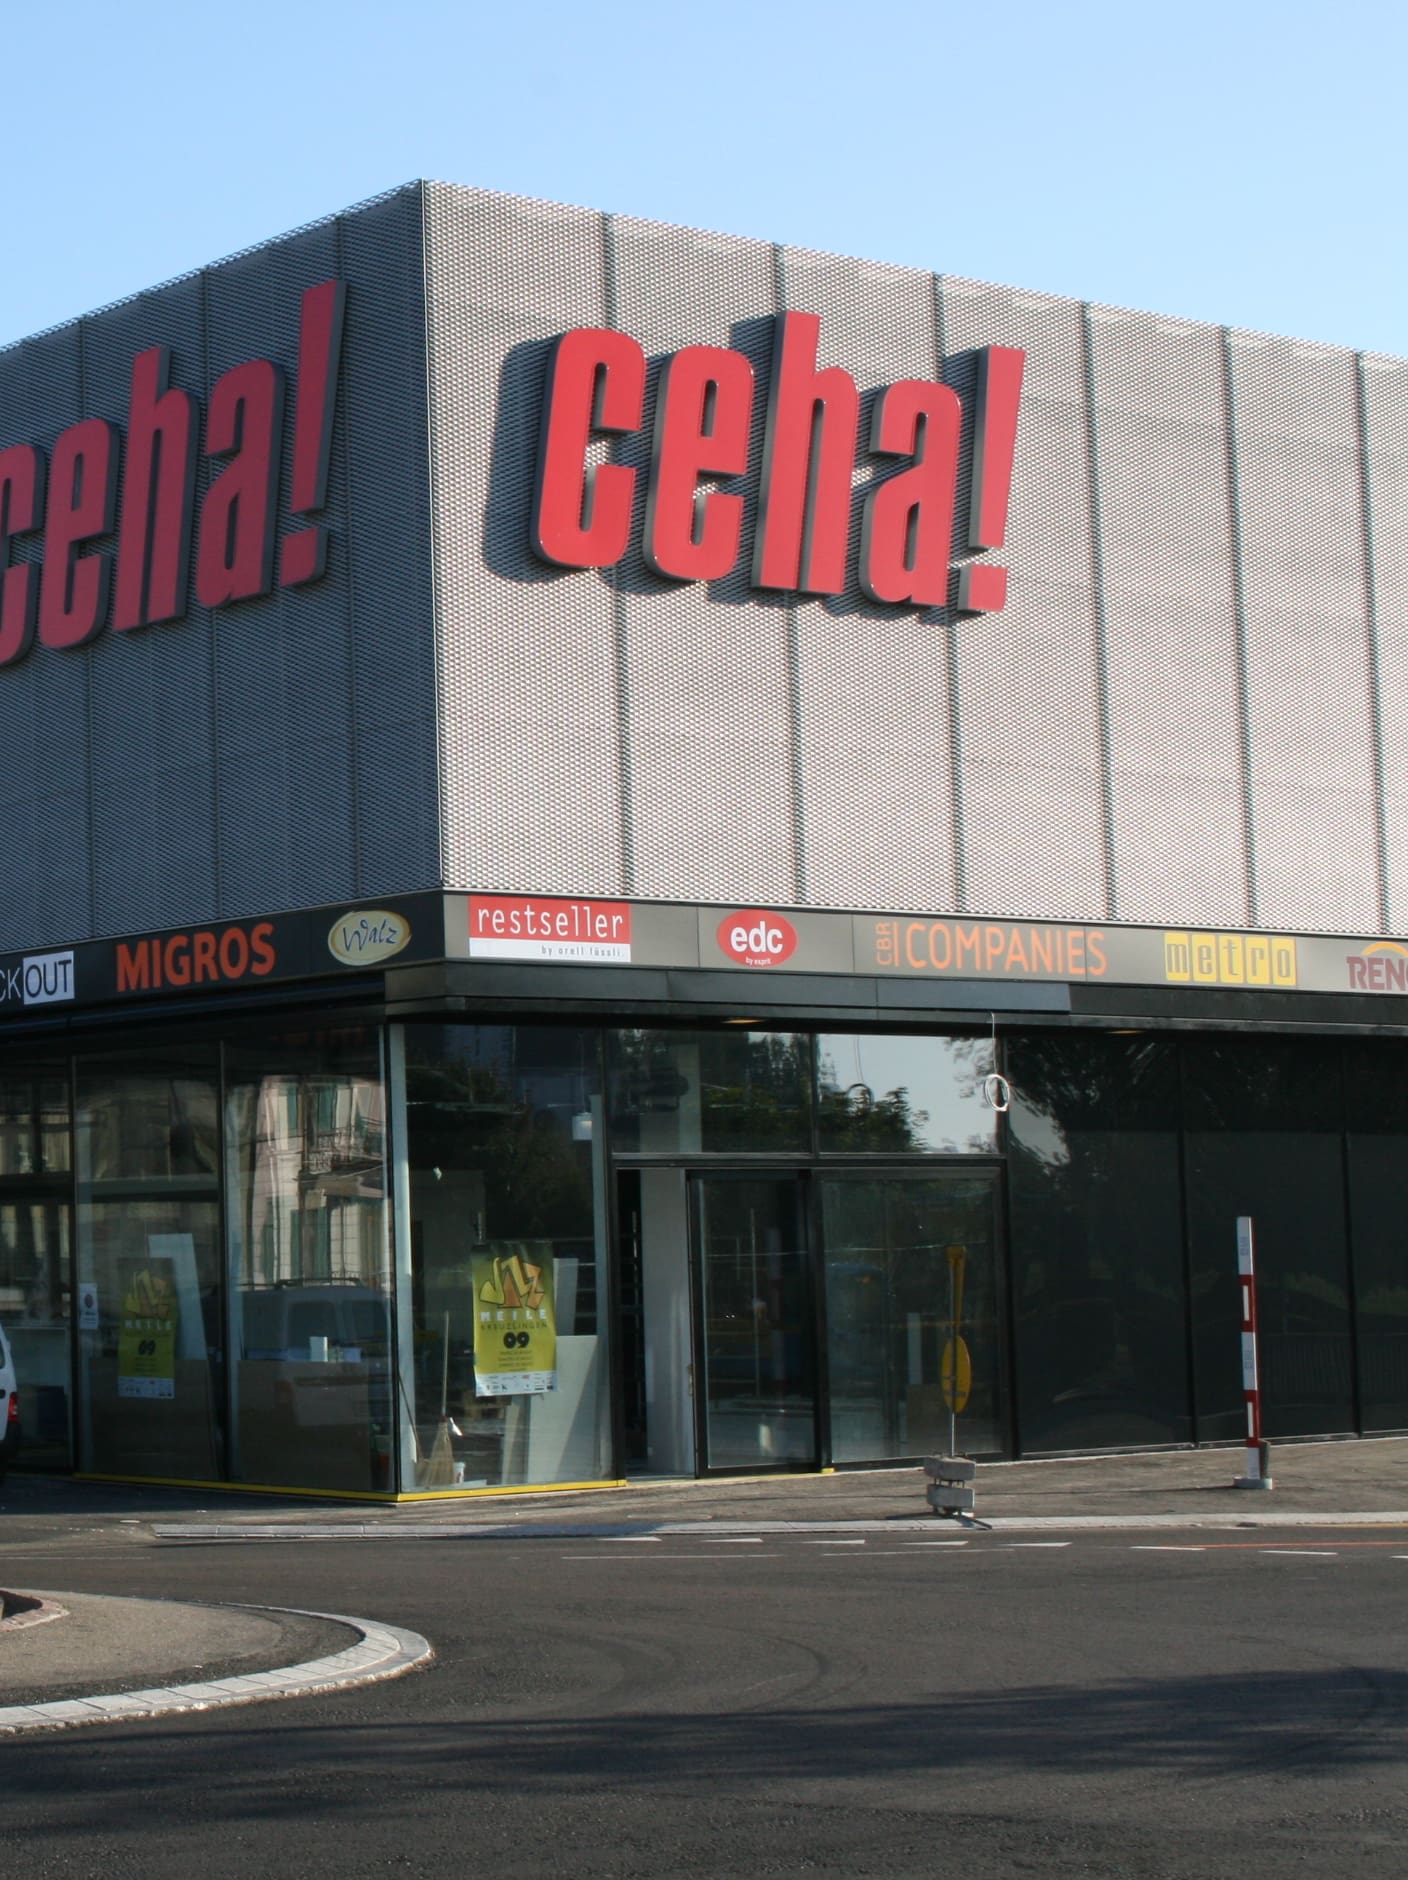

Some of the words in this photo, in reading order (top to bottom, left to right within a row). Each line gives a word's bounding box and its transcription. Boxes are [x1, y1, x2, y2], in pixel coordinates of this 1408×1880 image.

[531, 310, 1024, 613] ceha!
[342, 918, 399, 951] Walz
[477, 903, 624, 939] restseller
[730, 920, 783, 954] edc
[116, 922, 277, 993] MIGROS
[541, 945, 553, 957] by
[558, 945, 584, 957] orell
[875, 921, 892, 966] CBR
[906, 922, 1108, 977] COMPANIES
[1166, 936, 1294, 983] metro
[1346, 956, 1408, 991] REN
[480, 1308, 547, 1321] MEILE
[503, 1331, 530, 1349] 09
